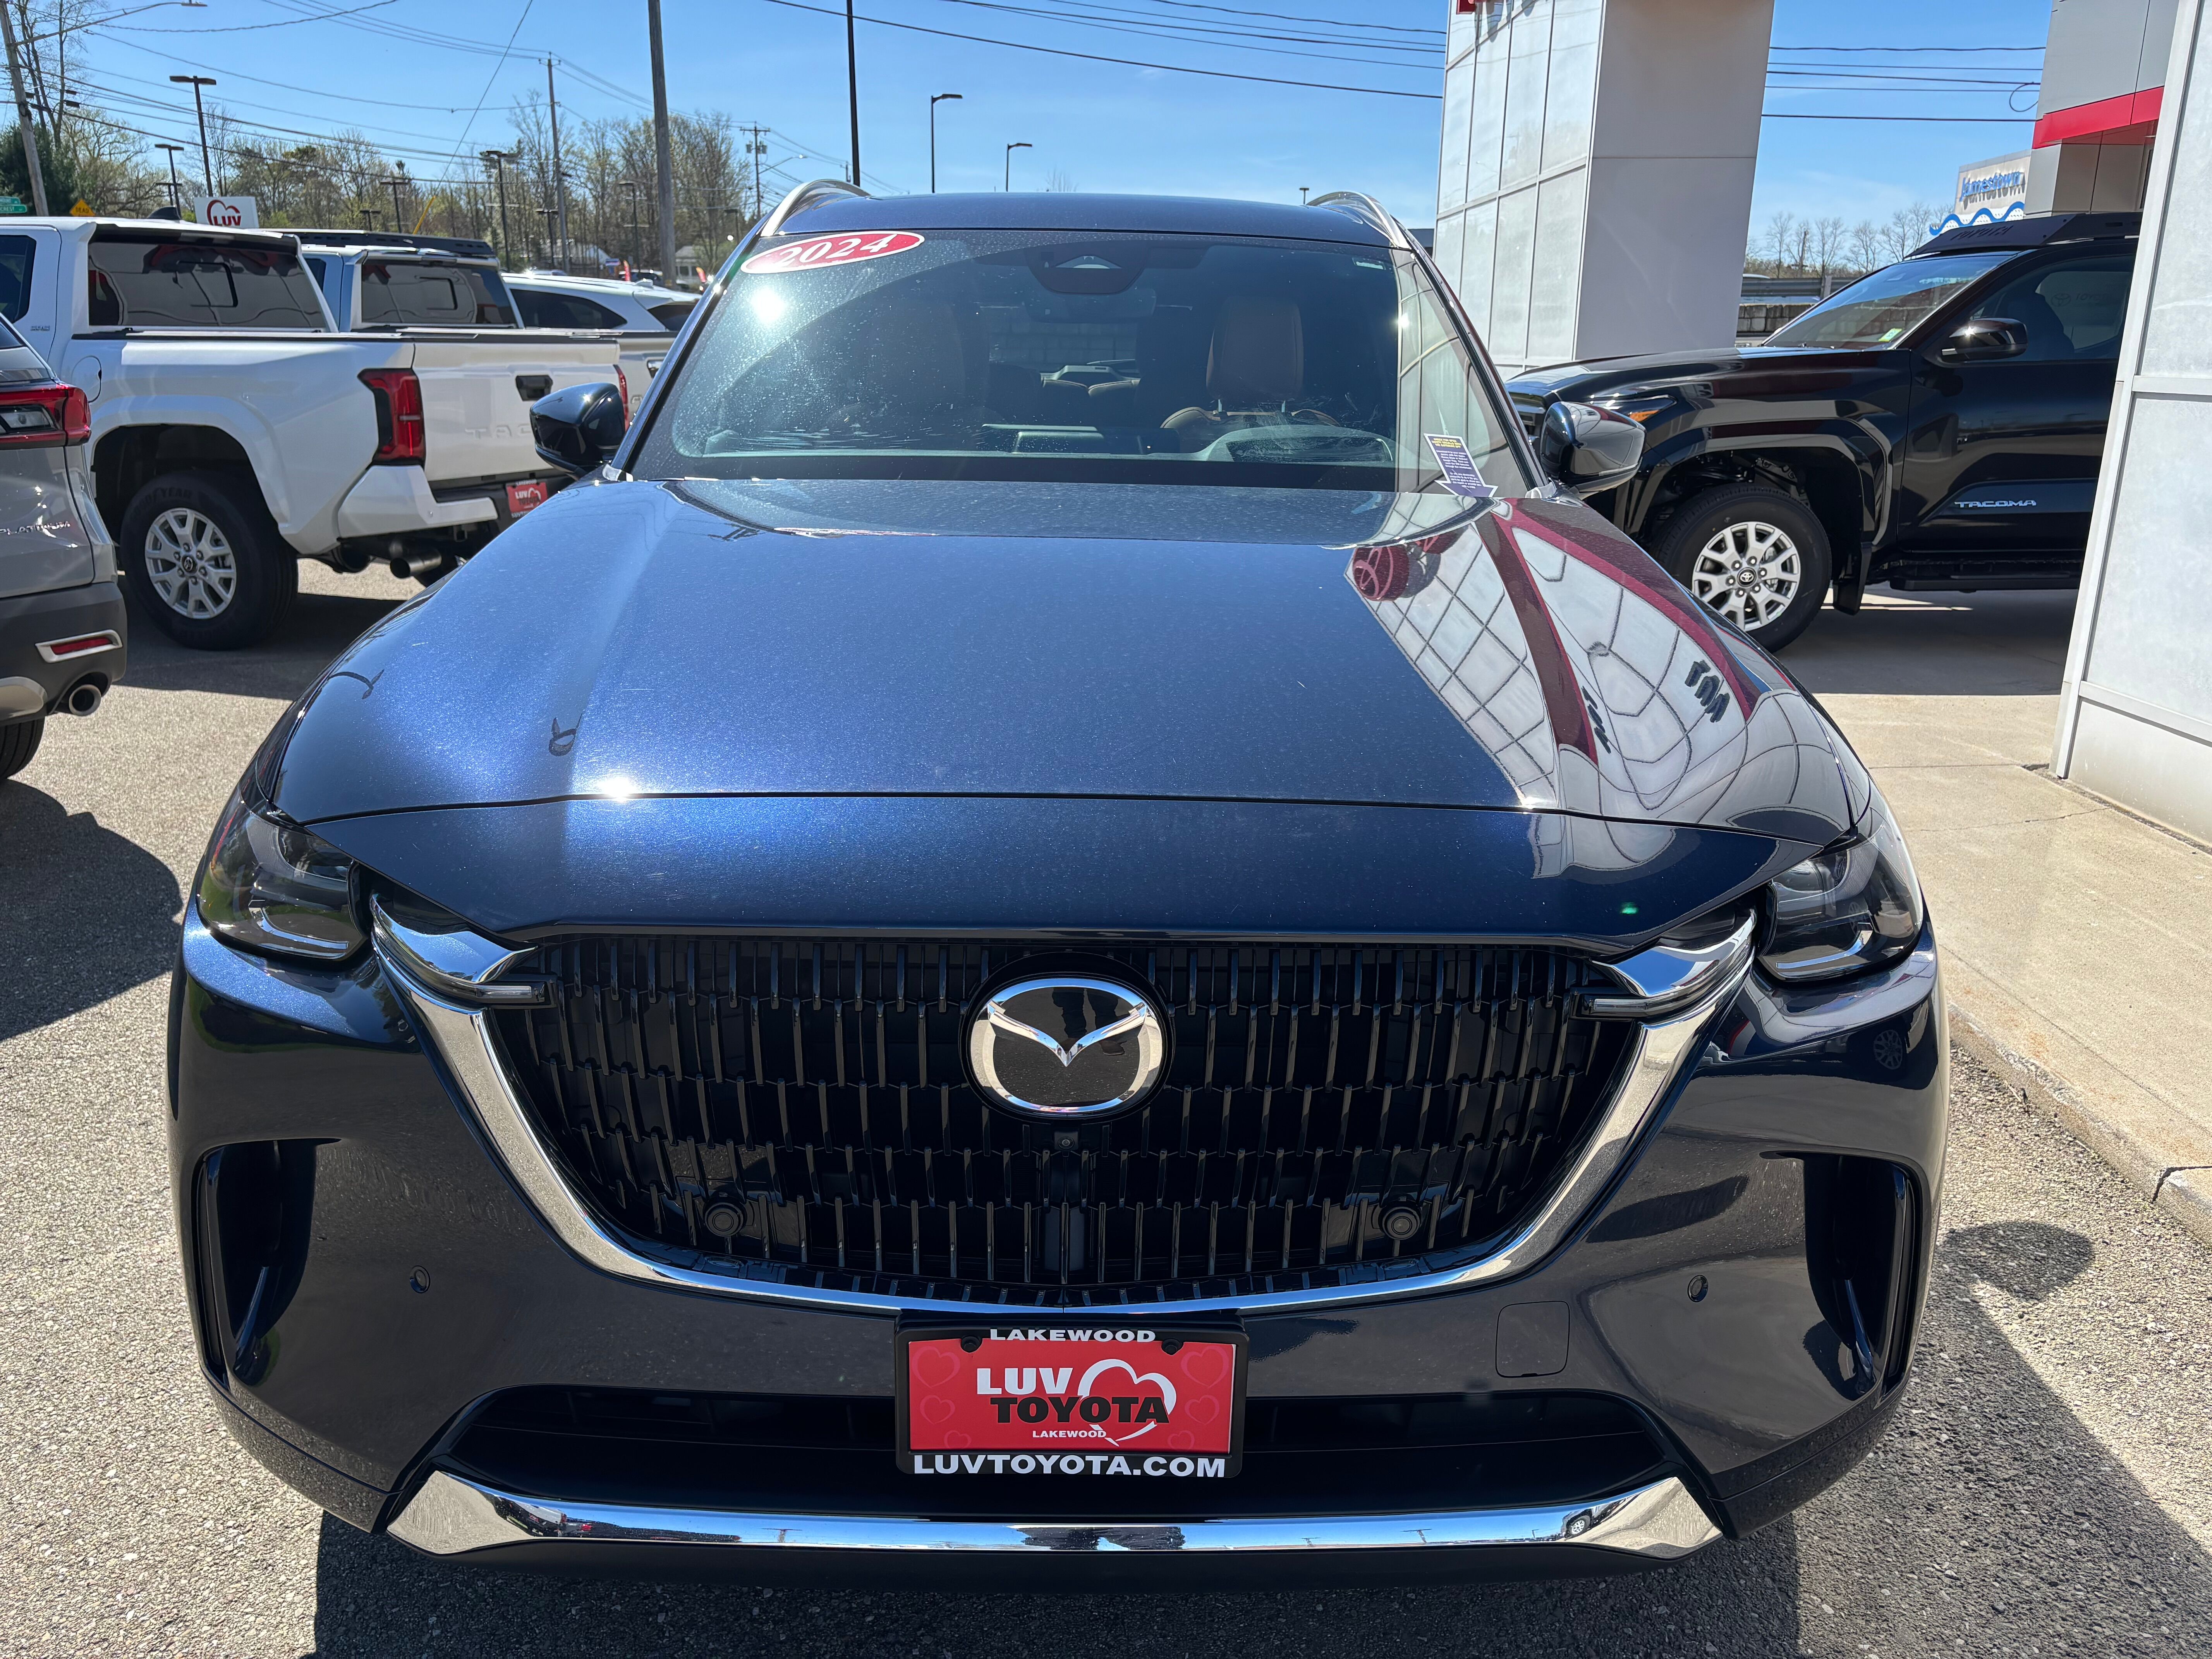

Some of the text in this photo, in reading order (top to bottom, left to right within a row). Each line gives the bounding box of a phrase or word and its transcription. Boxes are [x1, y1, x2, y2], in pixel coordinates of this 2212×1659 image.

[1959, 171, 2024, 202] Jamestown
[213, 215, 241, 226] LUV
[775, 234, 898, 267] 2024
[515, 490, 528, 499] LUV
[990, 1329, 1156, 1342] LAKEWOOD
[977, 1367, 1073, 1395] LUV
[990, 1396, 1170, 1423] TOYOTA
[914, 1455, 1225, 1478] LUVTOYOTA.COM
